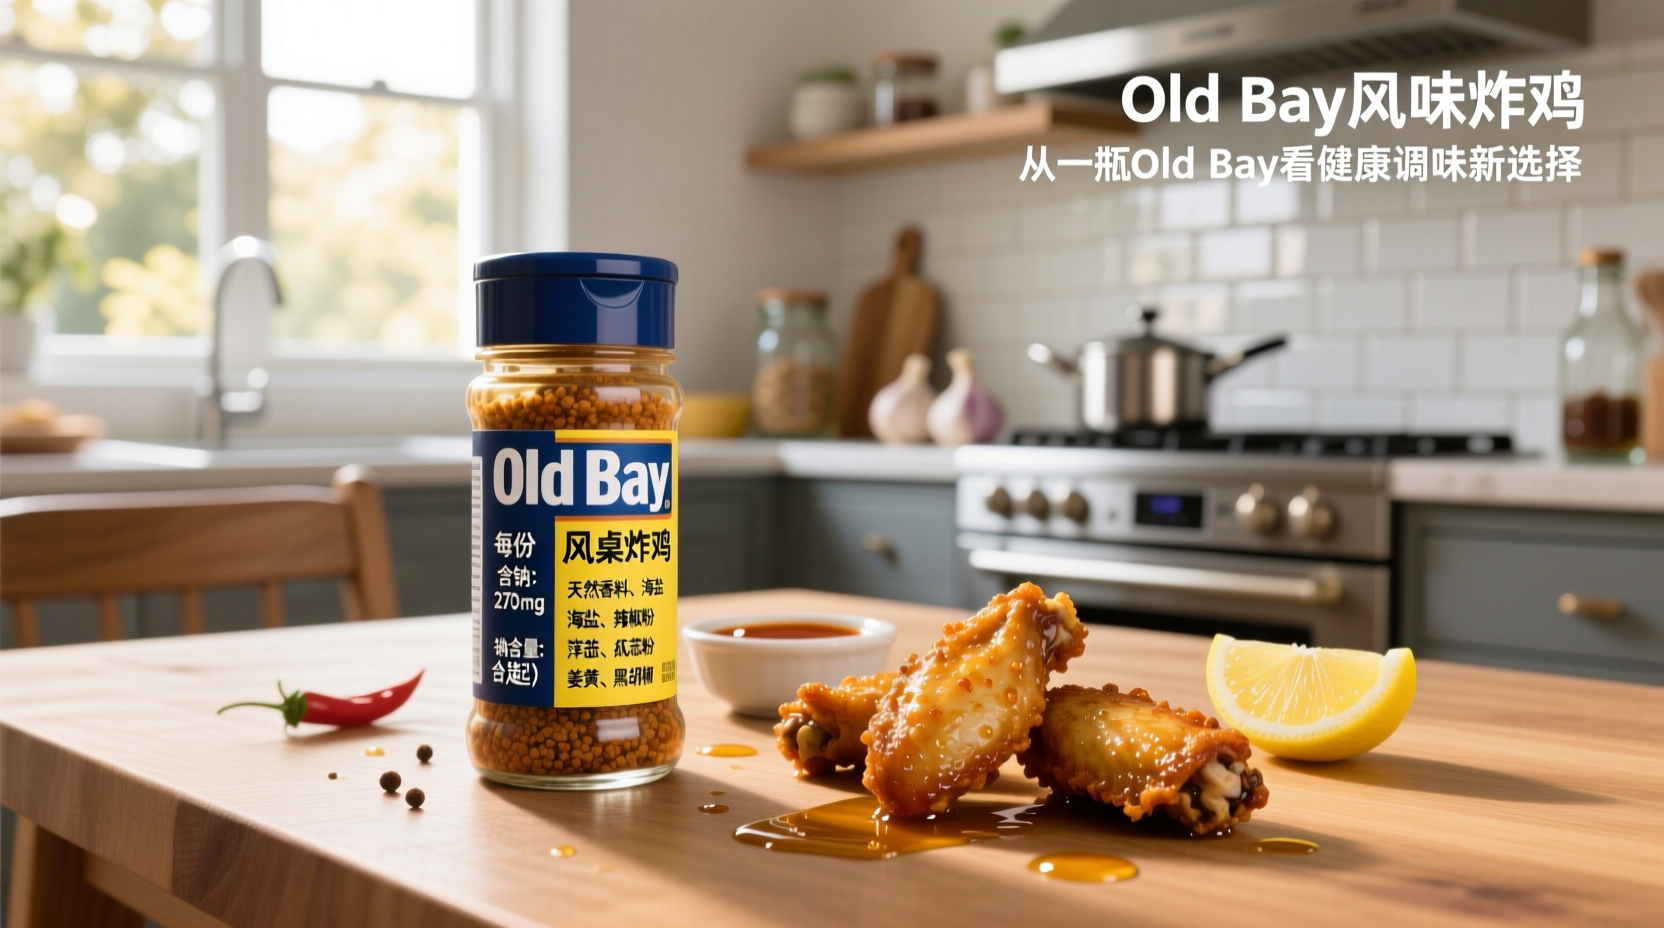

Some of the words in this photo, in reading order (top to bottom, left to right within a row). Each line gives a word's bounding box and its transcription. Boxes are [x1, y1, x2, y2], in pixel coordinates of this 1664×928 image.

[493, 447, 574, 506] Old
[586, 449, 670, 513] Bay
[494, 530, 536, 559] 每份
[494, 590, 545, 616] 270mg
